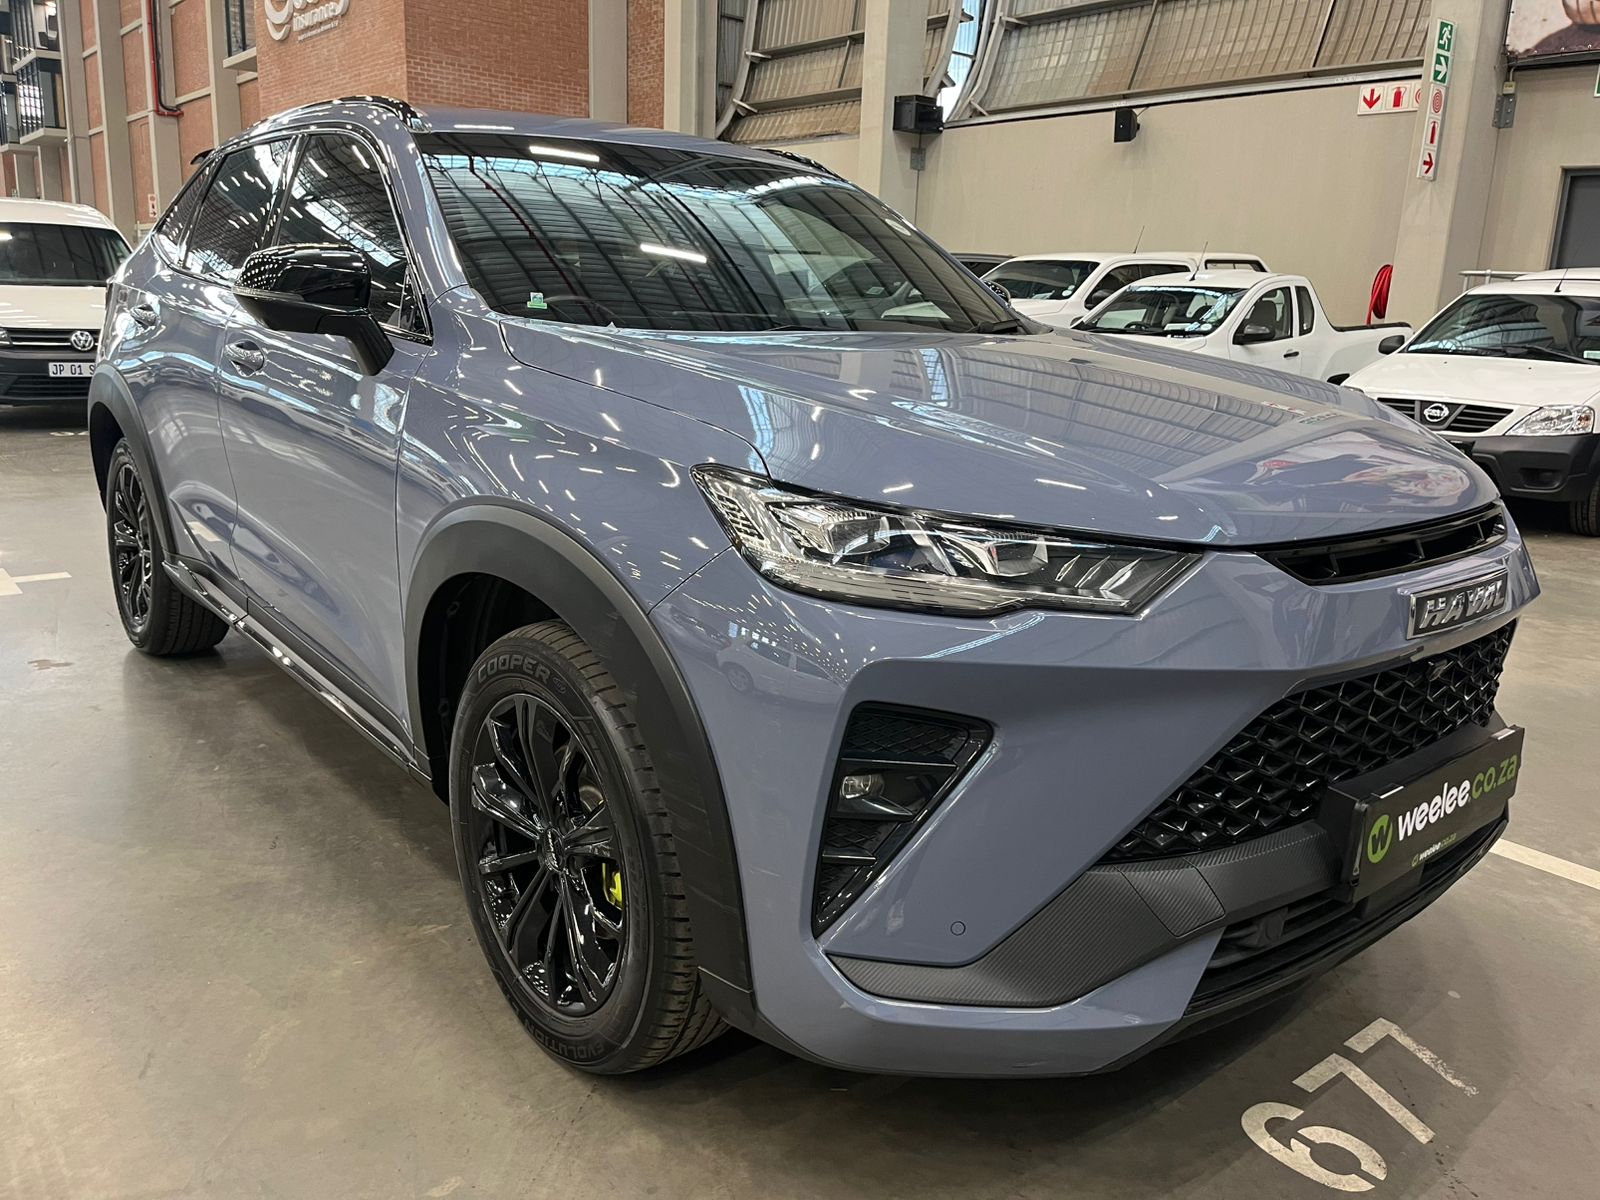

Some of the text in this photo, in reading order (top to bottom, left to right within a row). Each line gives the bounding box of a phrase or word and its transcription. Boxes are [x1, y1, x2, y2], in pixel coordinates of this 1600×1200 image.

[52, 364, 65, 375] JP
[70, 364, 83, 375] 01
[1419, 580, 1503, 629] HAVAL
[477, 654, 551, 685] COOPER
